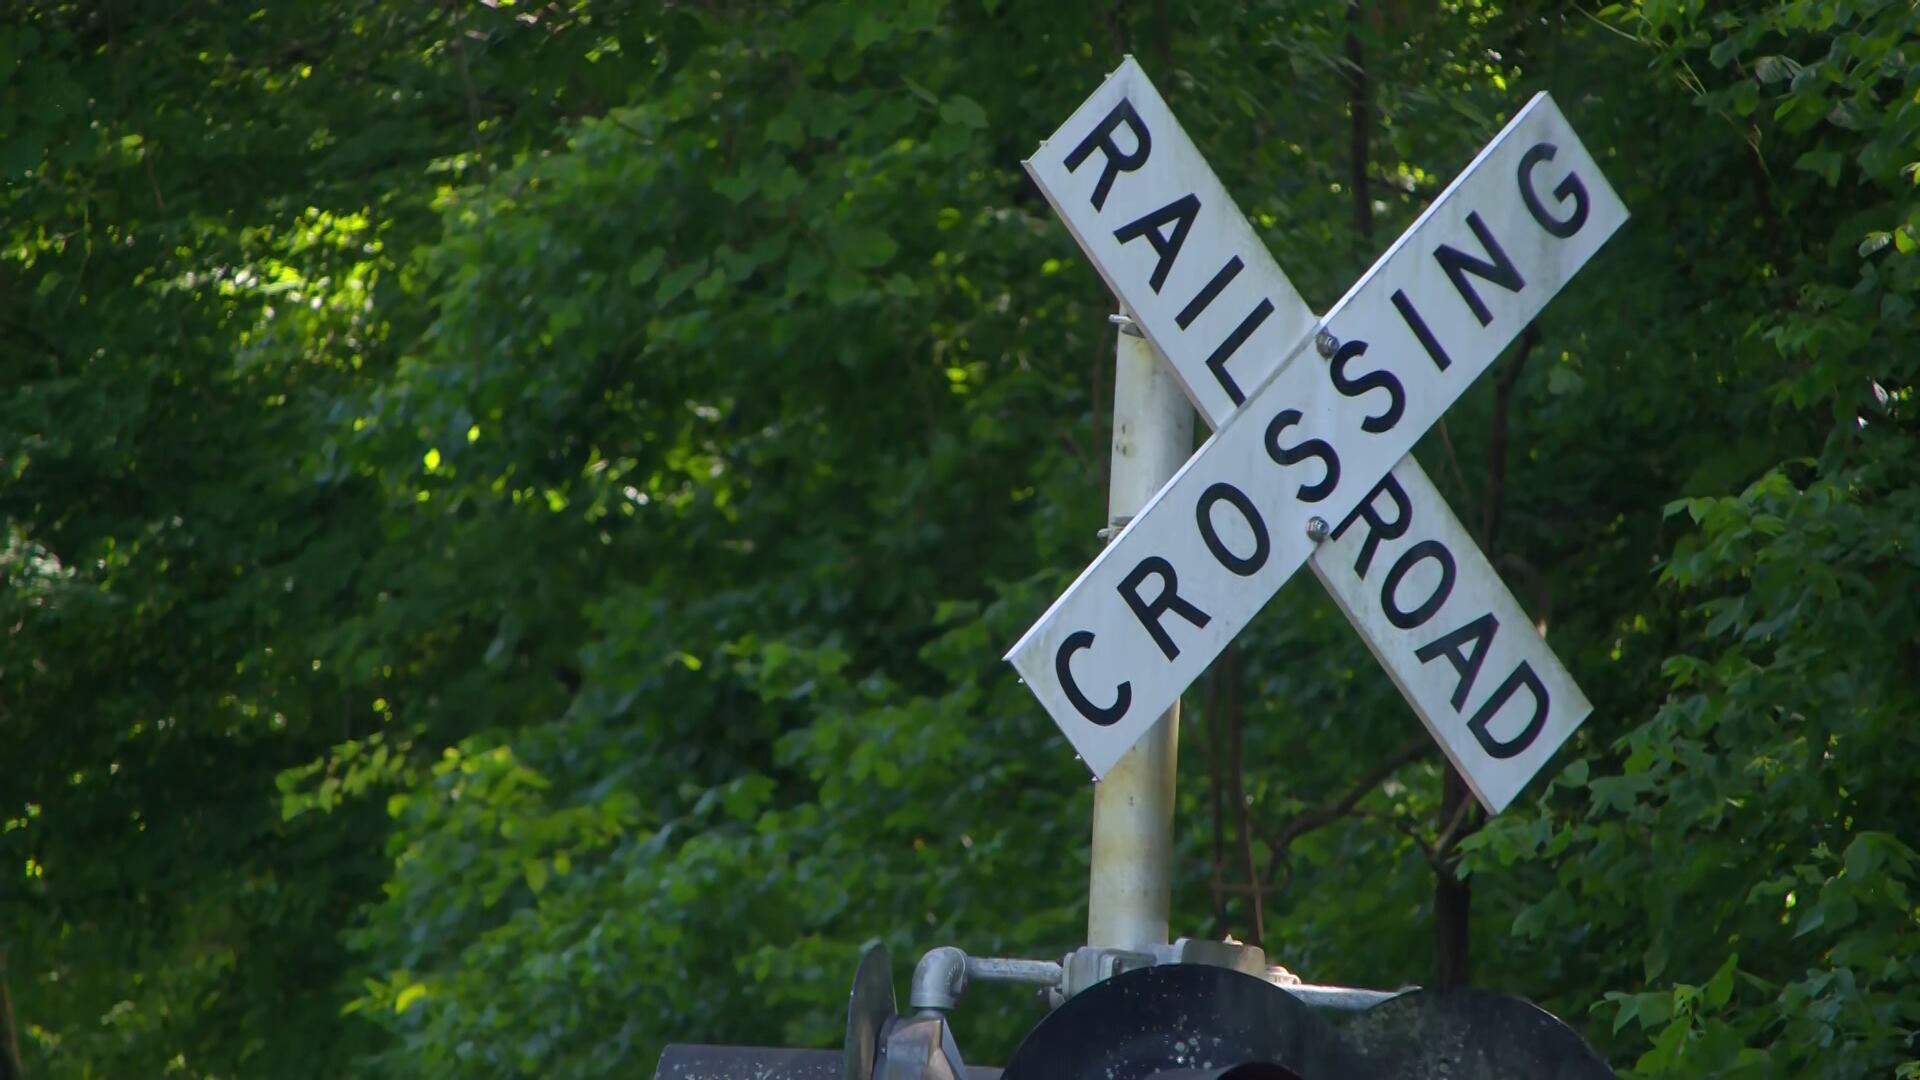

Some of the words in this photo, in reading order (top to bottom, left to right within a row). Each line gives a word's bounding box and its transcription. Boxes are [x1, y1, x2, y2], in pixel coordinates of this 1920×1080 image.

[1055, 141, 1590, 727] CROSSING
[1064, 97, 1275, 408] RAIL
[1330, 471, 1551, 760] ROAD
